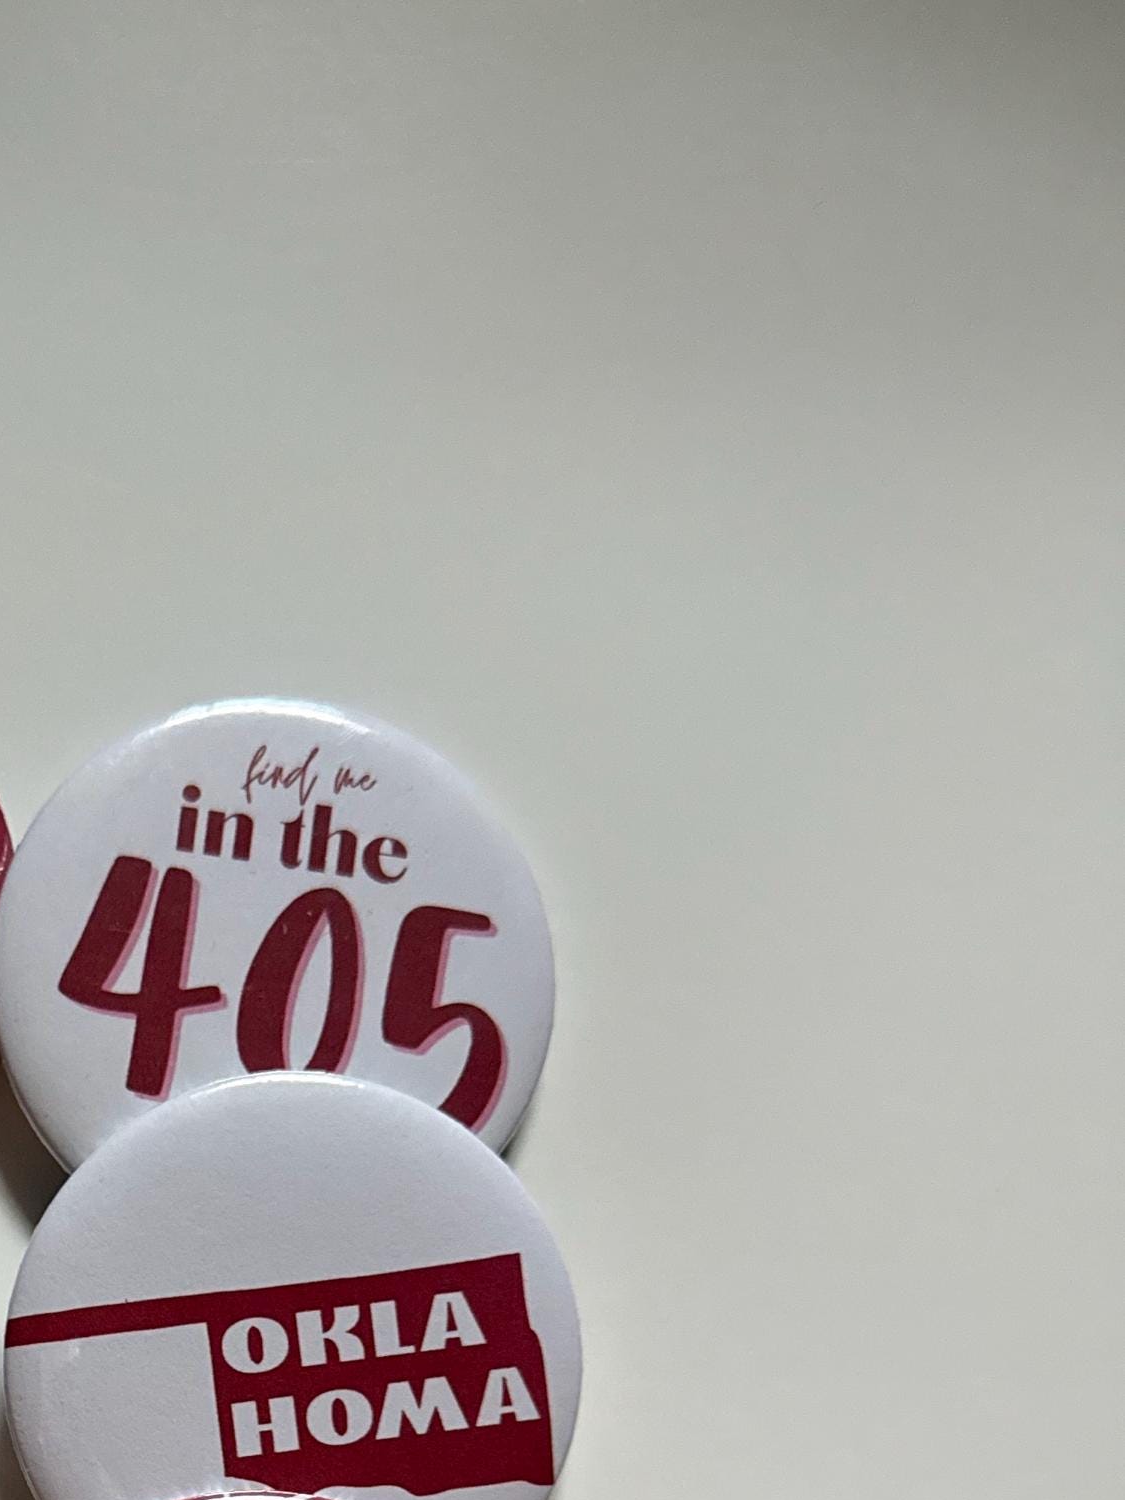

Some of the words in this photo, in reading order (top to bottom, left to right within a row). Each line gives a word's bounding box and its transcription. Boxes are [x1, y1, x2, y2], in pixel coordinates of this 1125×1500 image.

[243, 744, 320, 805] find
[334, 765, 378, 793] me
[176, 783, 255, 862] in
[280, 804, 409, 885] the
[57, 855, 508, 1135] 405
[221, 1290, 487, 1375] OKLA
[230, 1366, 542, 1458] HOMA
